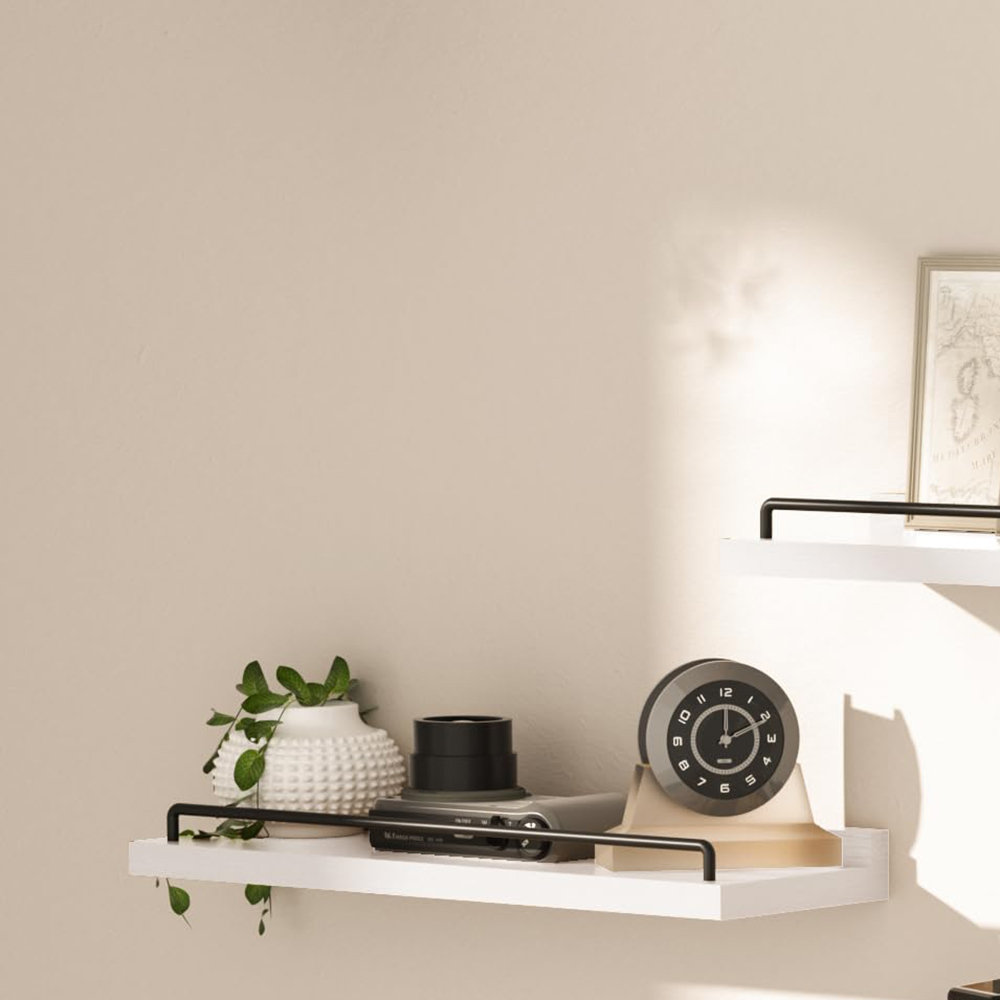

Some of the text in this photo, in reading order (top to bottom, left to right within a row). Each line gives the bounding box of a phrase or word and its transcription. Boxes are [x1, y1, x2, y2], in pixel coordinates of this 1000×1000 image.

[719, 687, 733, 697] 12
[697, 694, 706, 704] 11
[747, 696, 754, 704] 1
[678, 709, 691, 725] 10
[760, 710, 771, 722] 2
[673, 736, 683, 747] 9
[767, 733, 777, 743] 3
[678, 759, 690, 771] 8
[763, 756, 772, 766] 4
[697, 777, 707, 786] 7
[745, 774, 756, 786] 5
[720, 783, 730, 793] 6
